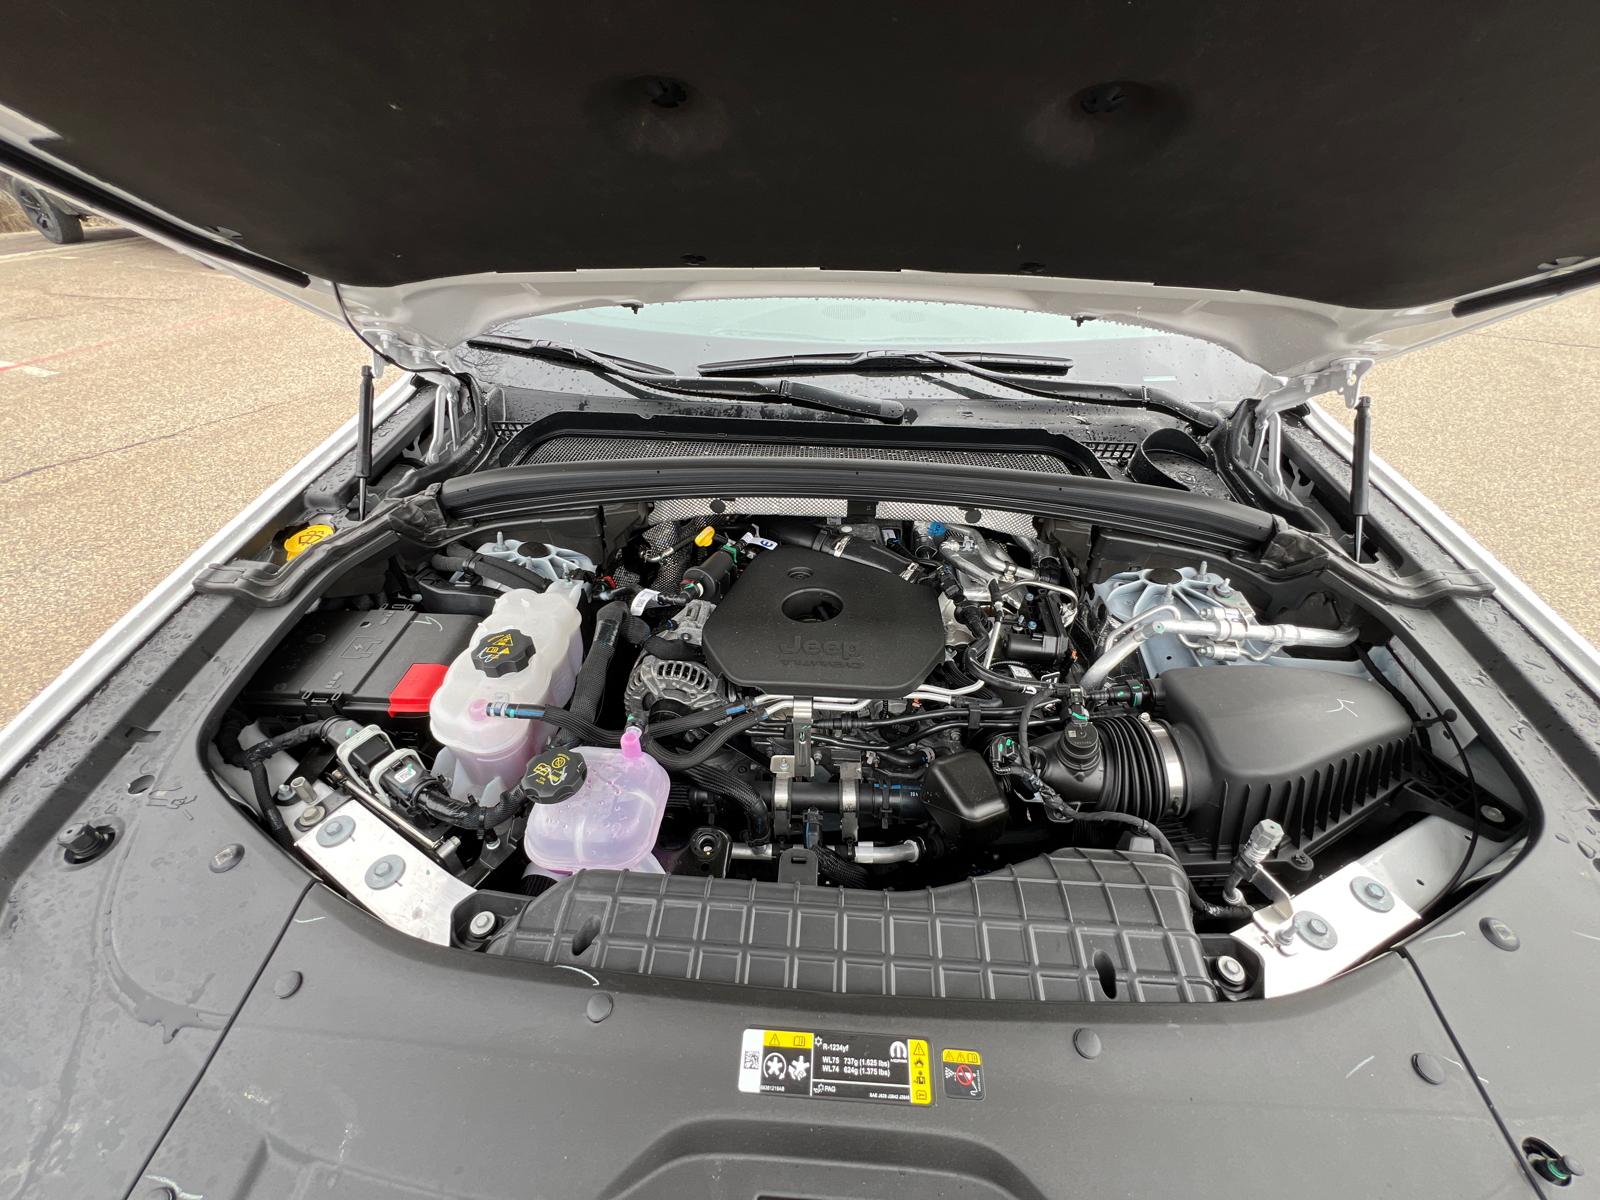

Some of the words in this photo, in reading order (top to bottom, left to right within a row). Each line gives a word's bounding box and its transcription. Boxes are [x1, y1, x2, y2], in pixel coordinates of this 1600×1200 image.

[780, 635, 862, 660] Jeep
[822, 1043, 849, 1053] R-1234yf
[822, 1056, 840, 1064] WL75
[843, 1057, 859, 1067] 737g
[878, 1059, 890, 1068] lbs)
[822, 1064, 840, 1073] WL74
[843, 1066, 859, 1075] 624g
[859, 1067, 878, 1076] (1.375
[878, 1068, 890, 1077] lbs)
